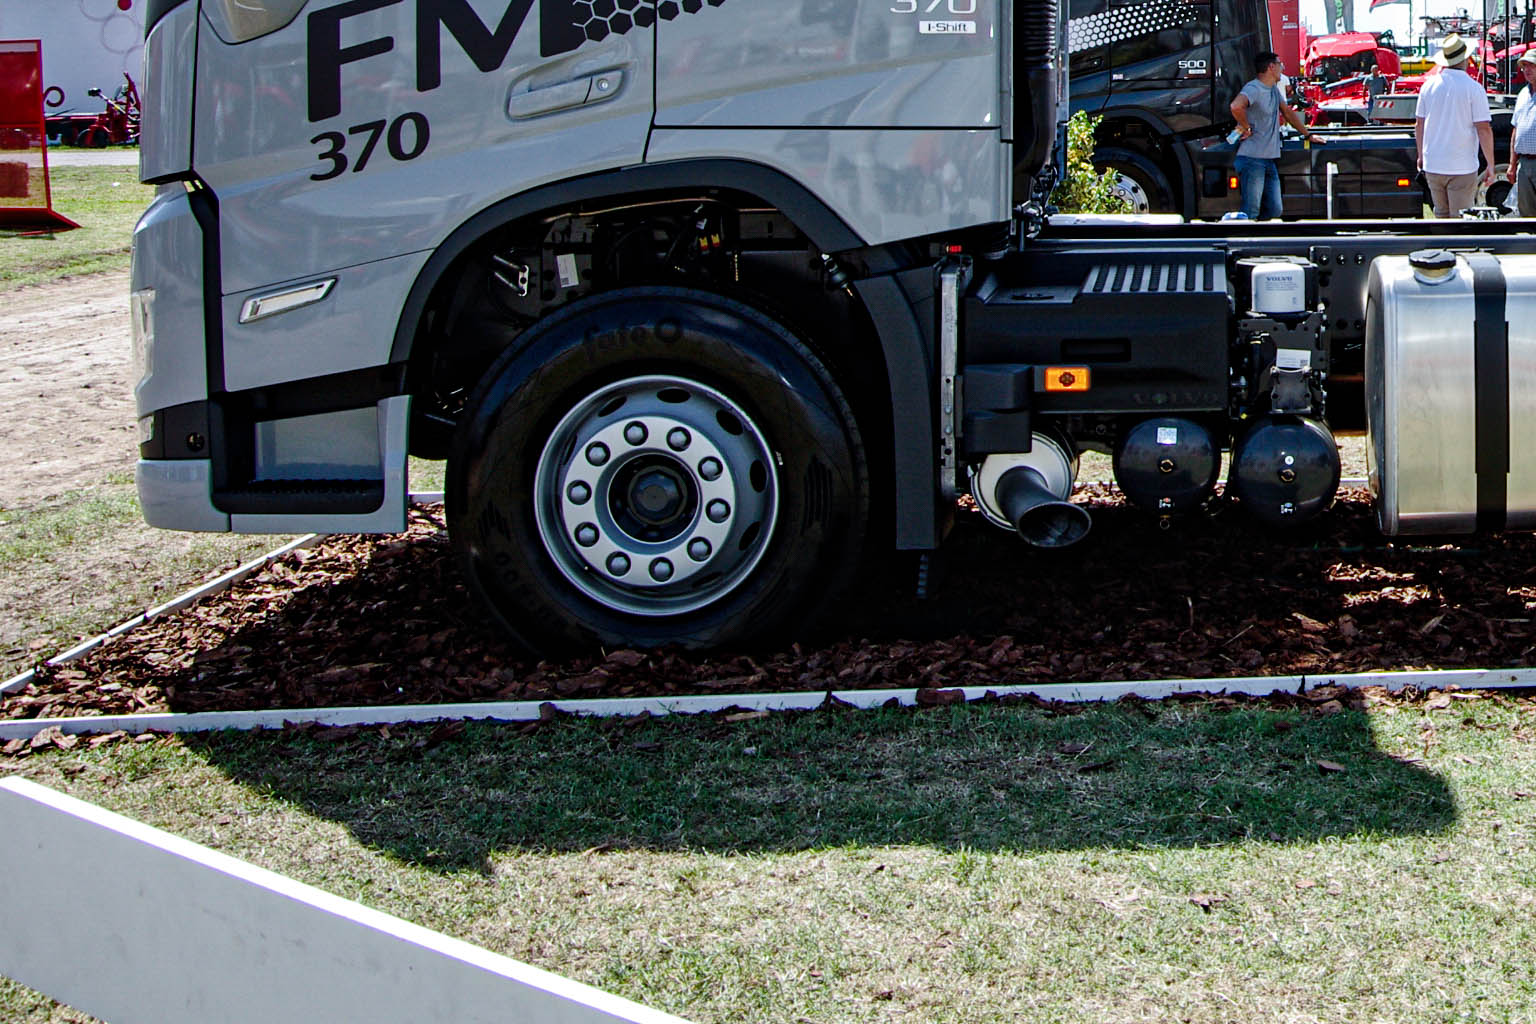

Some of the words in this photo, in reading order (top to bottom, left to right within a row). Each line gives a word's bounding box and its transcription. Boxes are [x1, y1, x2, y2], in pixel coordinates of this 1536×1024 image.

[927, 22, 968, 32] I-Shift
[1178, 60, 1207, 69] 500
[310, 111, 431, 181] 370
